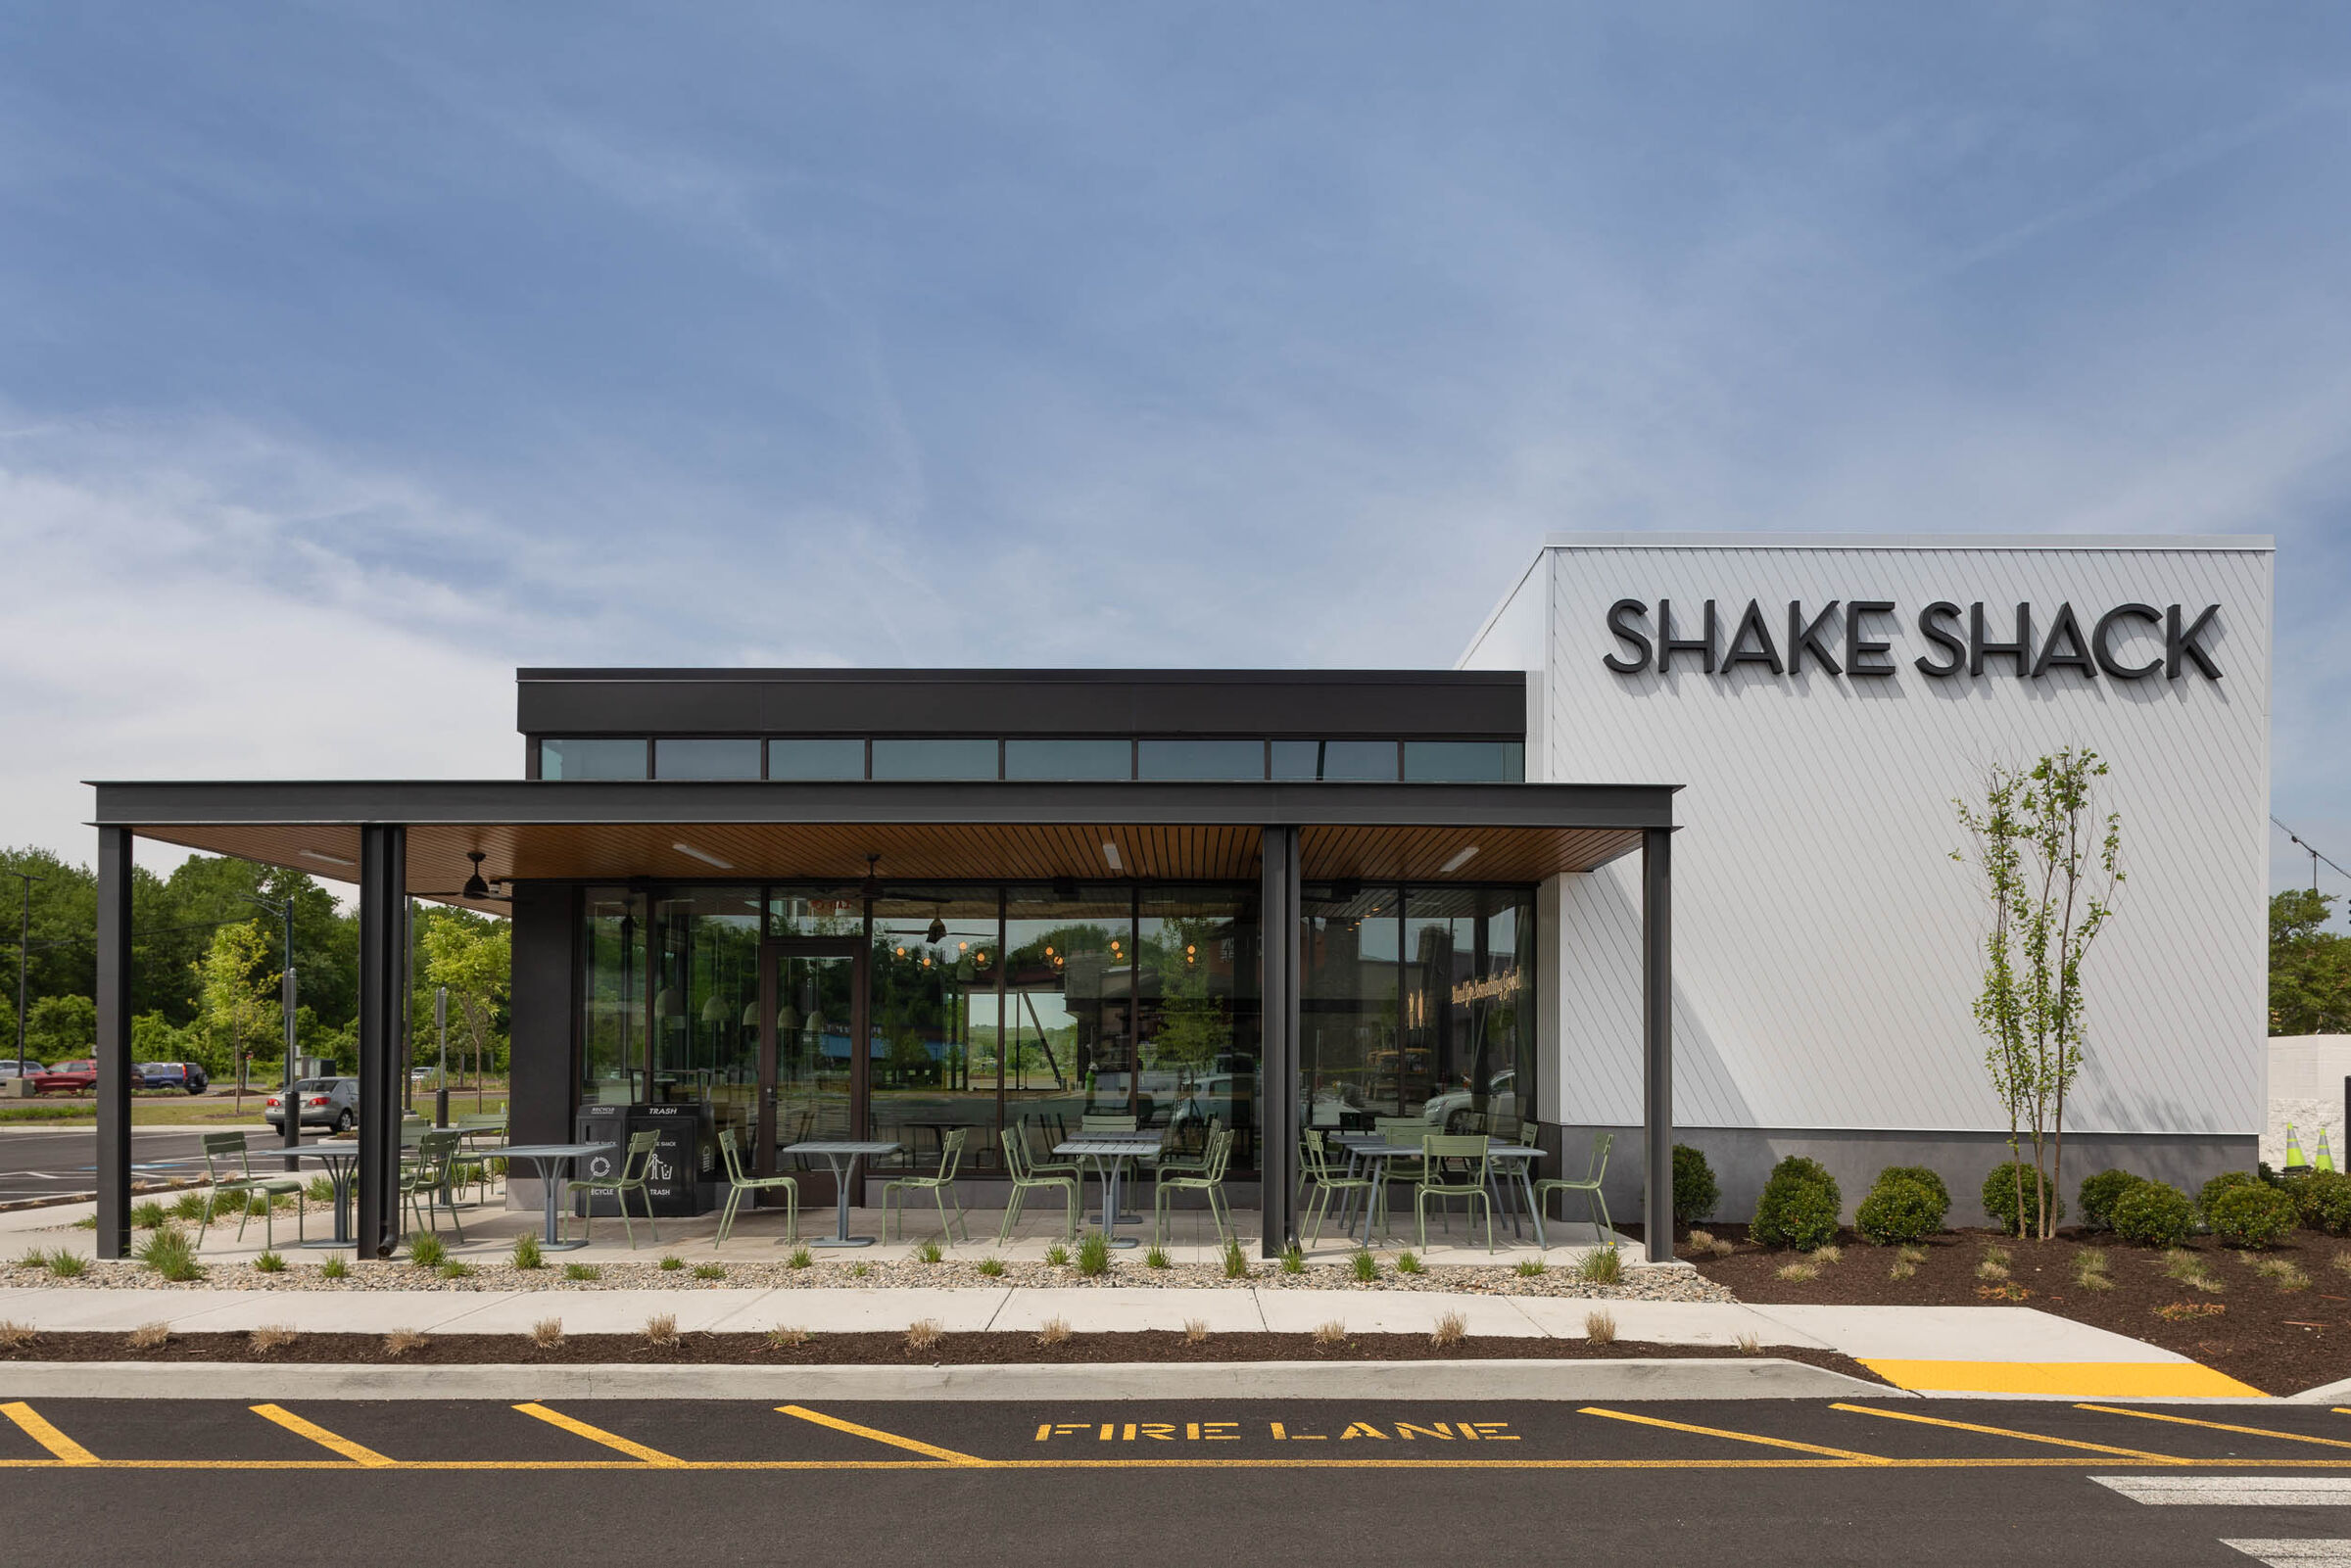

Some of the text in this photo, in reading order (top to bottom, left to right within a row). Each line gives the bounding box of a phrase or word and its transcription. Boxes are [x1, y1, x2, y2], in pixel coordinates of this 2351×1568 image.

[1602, 597, 2224, 680] SHAKE SHACK
[1033, 1422, 1521, 1442] FIRE LANE
